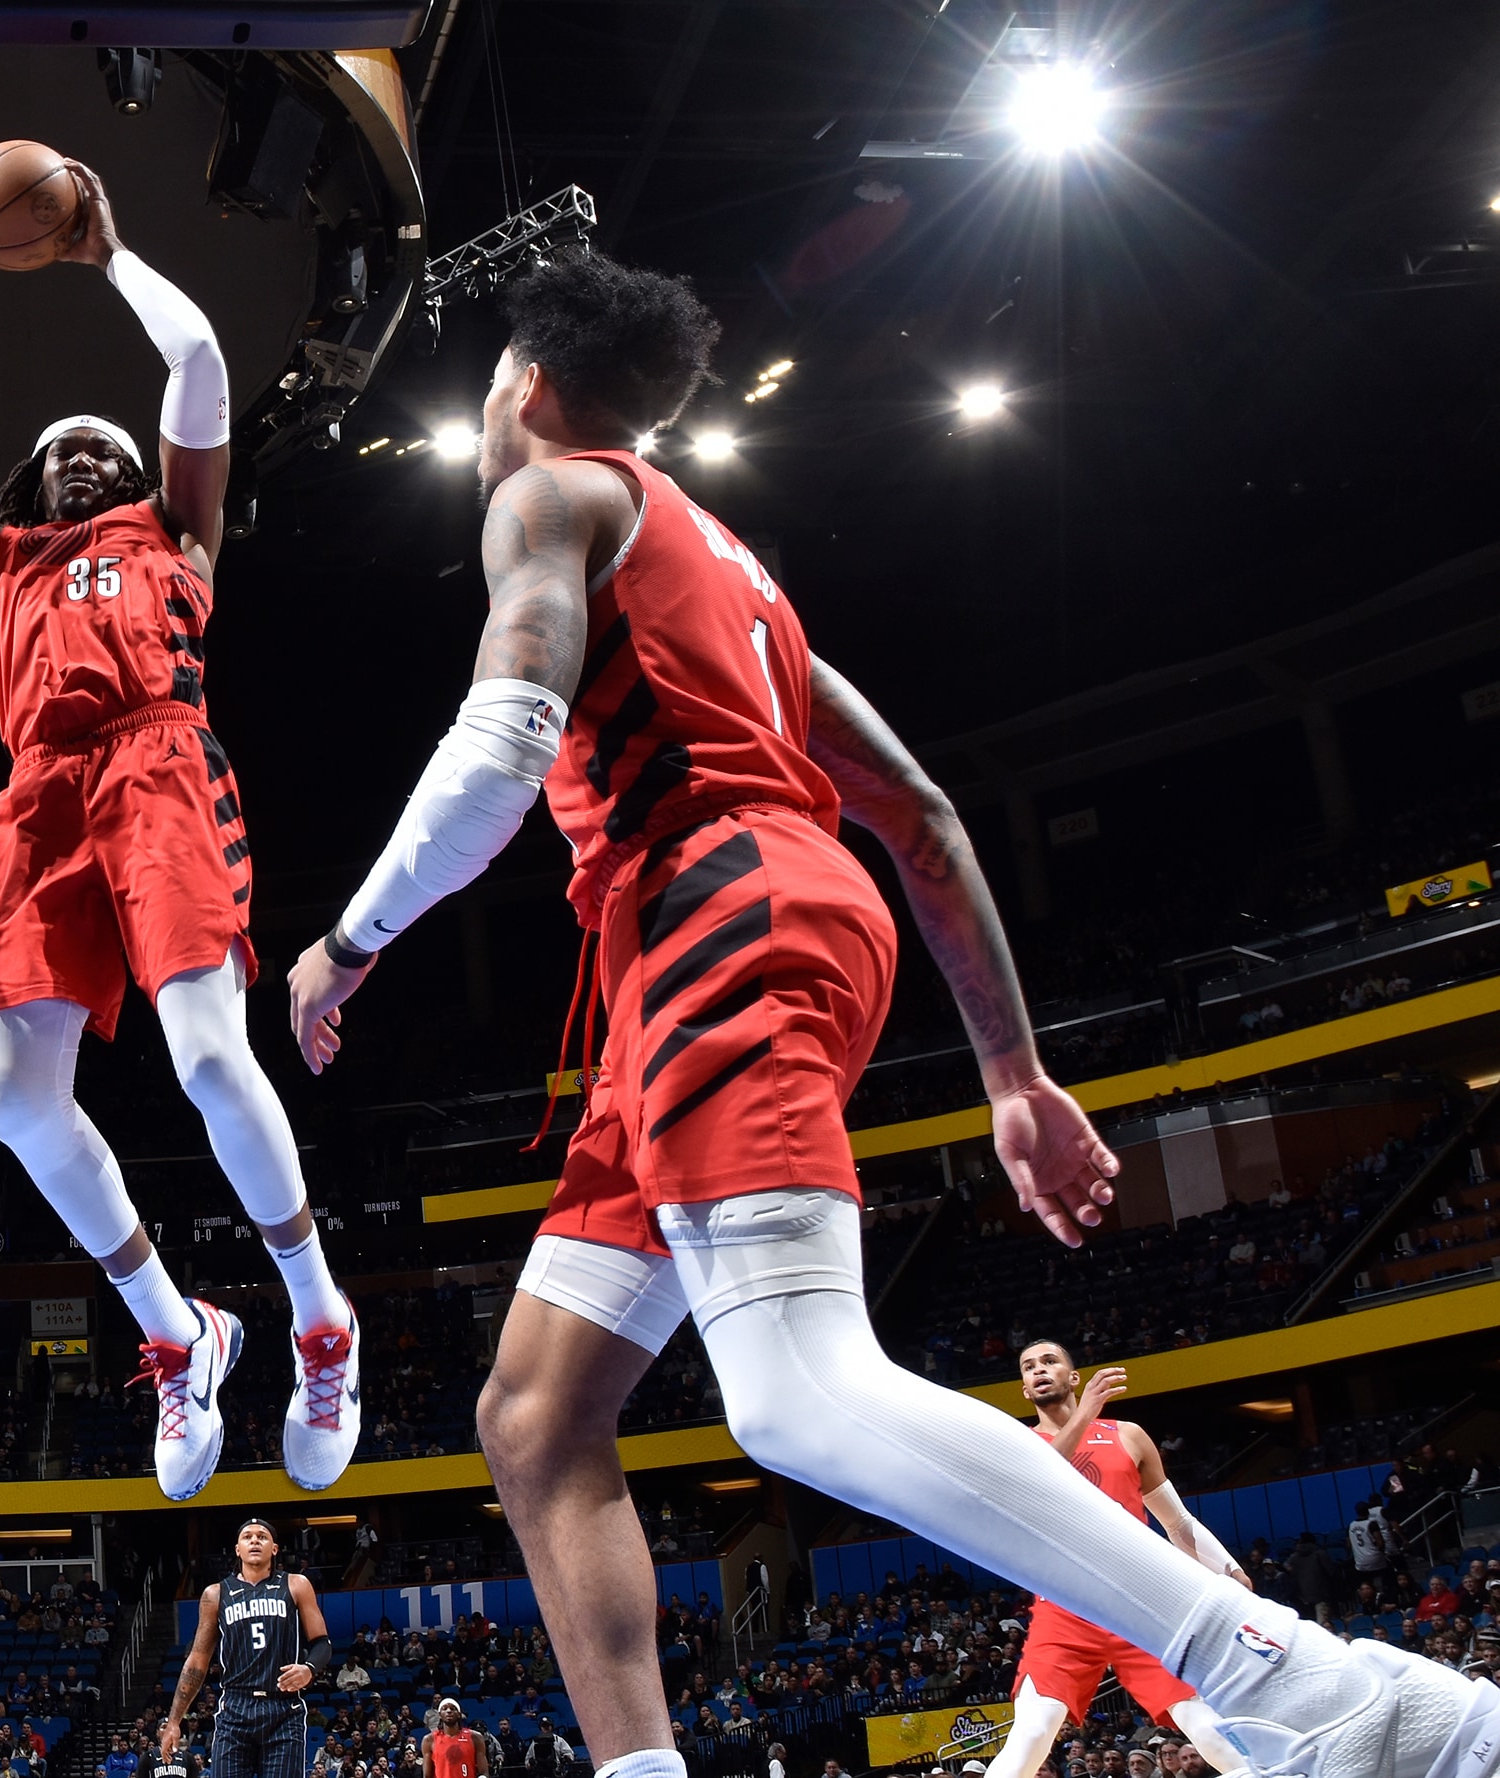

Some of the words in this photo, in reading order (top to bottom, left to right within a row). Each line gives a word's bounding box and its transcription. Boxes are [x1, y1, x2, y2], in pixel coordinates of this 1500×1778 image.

[66, 556, 122, 602] 35
[750, 616, 783, 737] 1
[1058, 816, 1088, 835] 220
[363, 1201, 400, 1213] TURNOVERS
[194, 1218, 201, 1228] FT
[202, 1216, 232, 1227] SHOOTING
[327, 1217, 344, 1231] 0%
[155, 1223, 163, 1242] 7
[235, 1225, 251, 1239] 0%
[45, 1302, 74, 1312] 110A
[45, 1315, 74, 1325] 111A
[224, 1598, 287, 1625] ORLANDO
[400, 1581, 484, 1636] 111
[251, 1622, 266, 1650] 5
[153, 1765, 187, 1778] ORLANDO
[461, 1763, 468, 1777] 9
